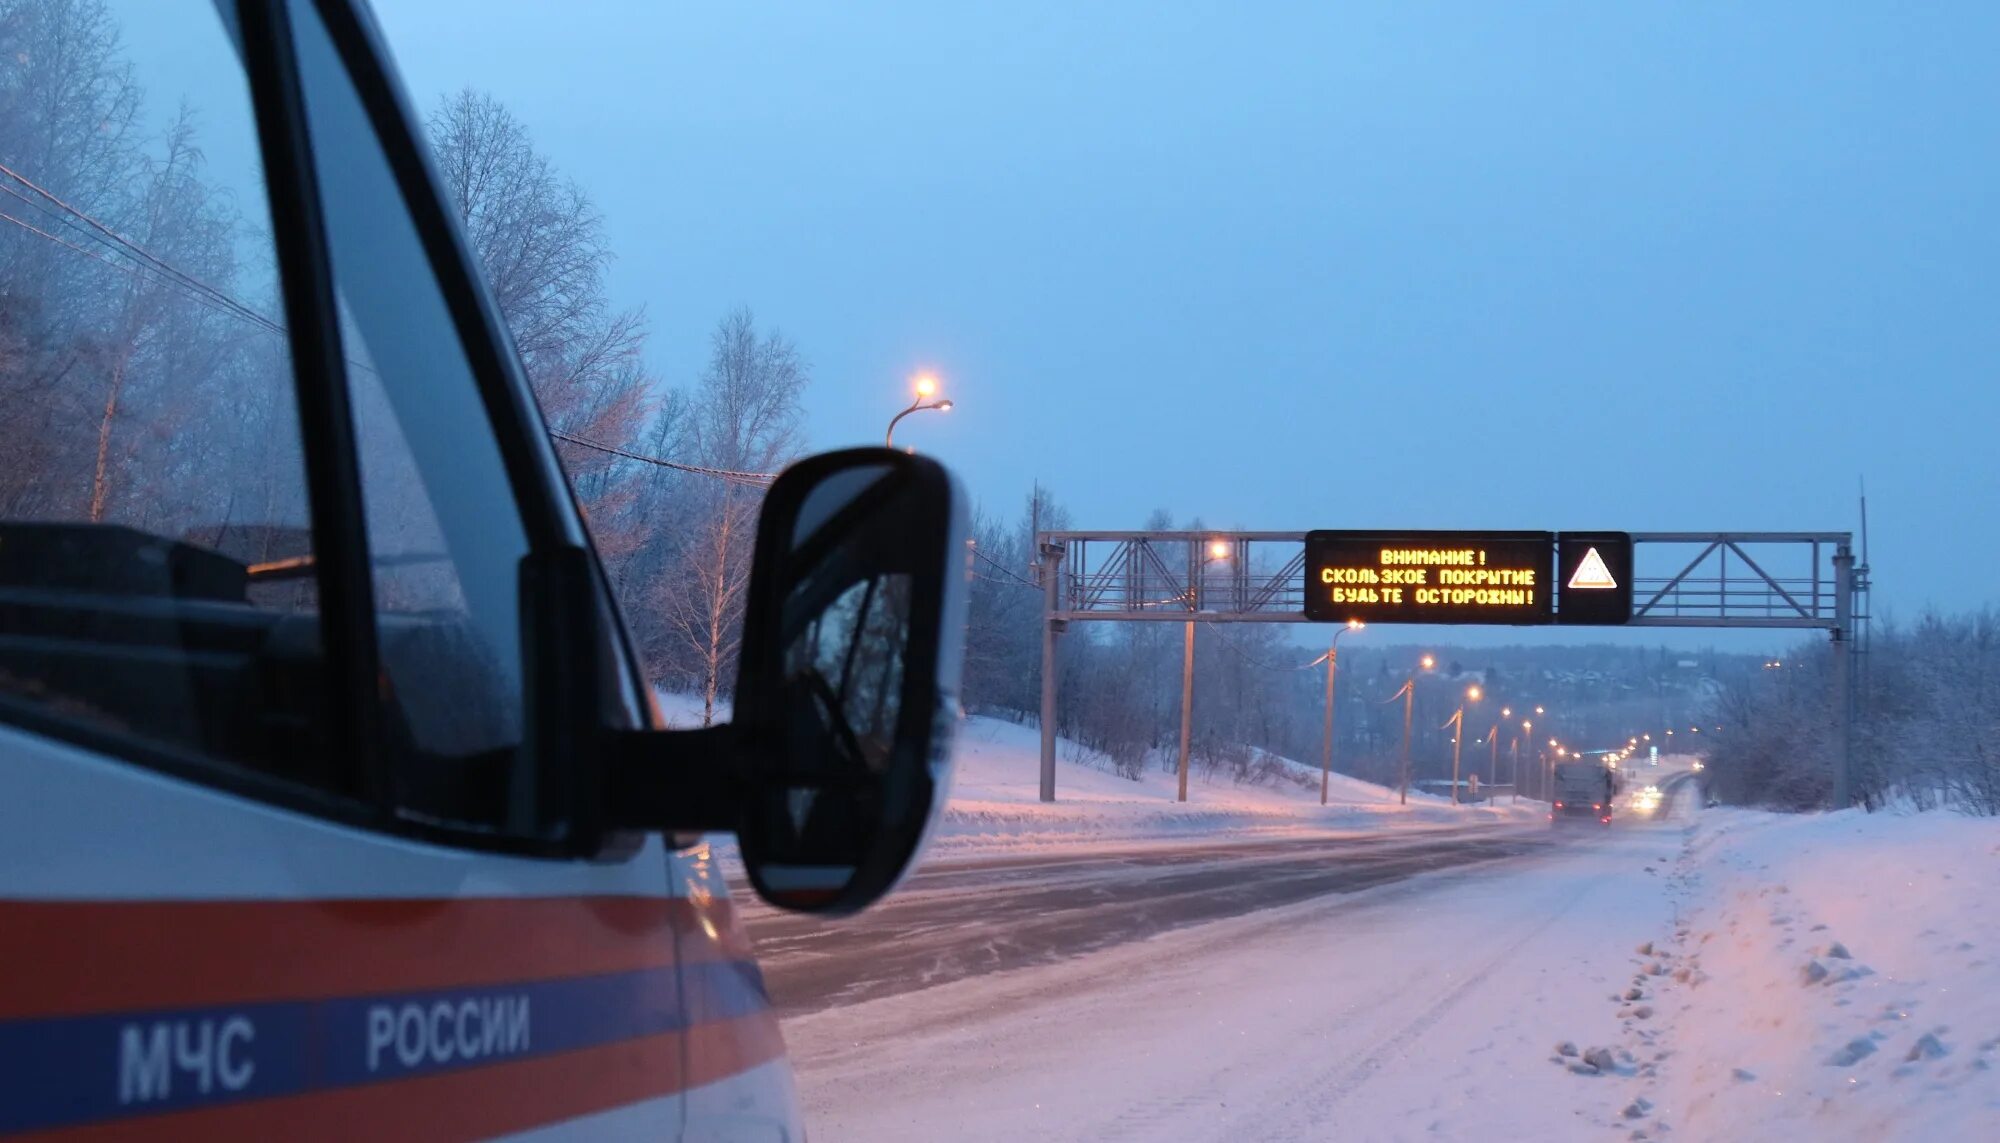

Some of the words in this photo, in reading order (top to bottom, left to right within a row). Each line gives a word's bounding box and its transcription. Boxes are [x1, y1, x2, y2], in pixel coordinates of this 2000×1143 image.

[1321, 569, 1427, 585] СКОЛЬЗКОЕ
[1439, 569, 1536, 585] ПОКРЫТИЕ
[1332, 588, 1403, 604] БУДЬТЕ
[1415, 588, 1535, 605] ОСТОРОЖНЫ!
[119, 1014, 256, 1104] МЧС
[367, 996, 531, 1071] РОССИИ
